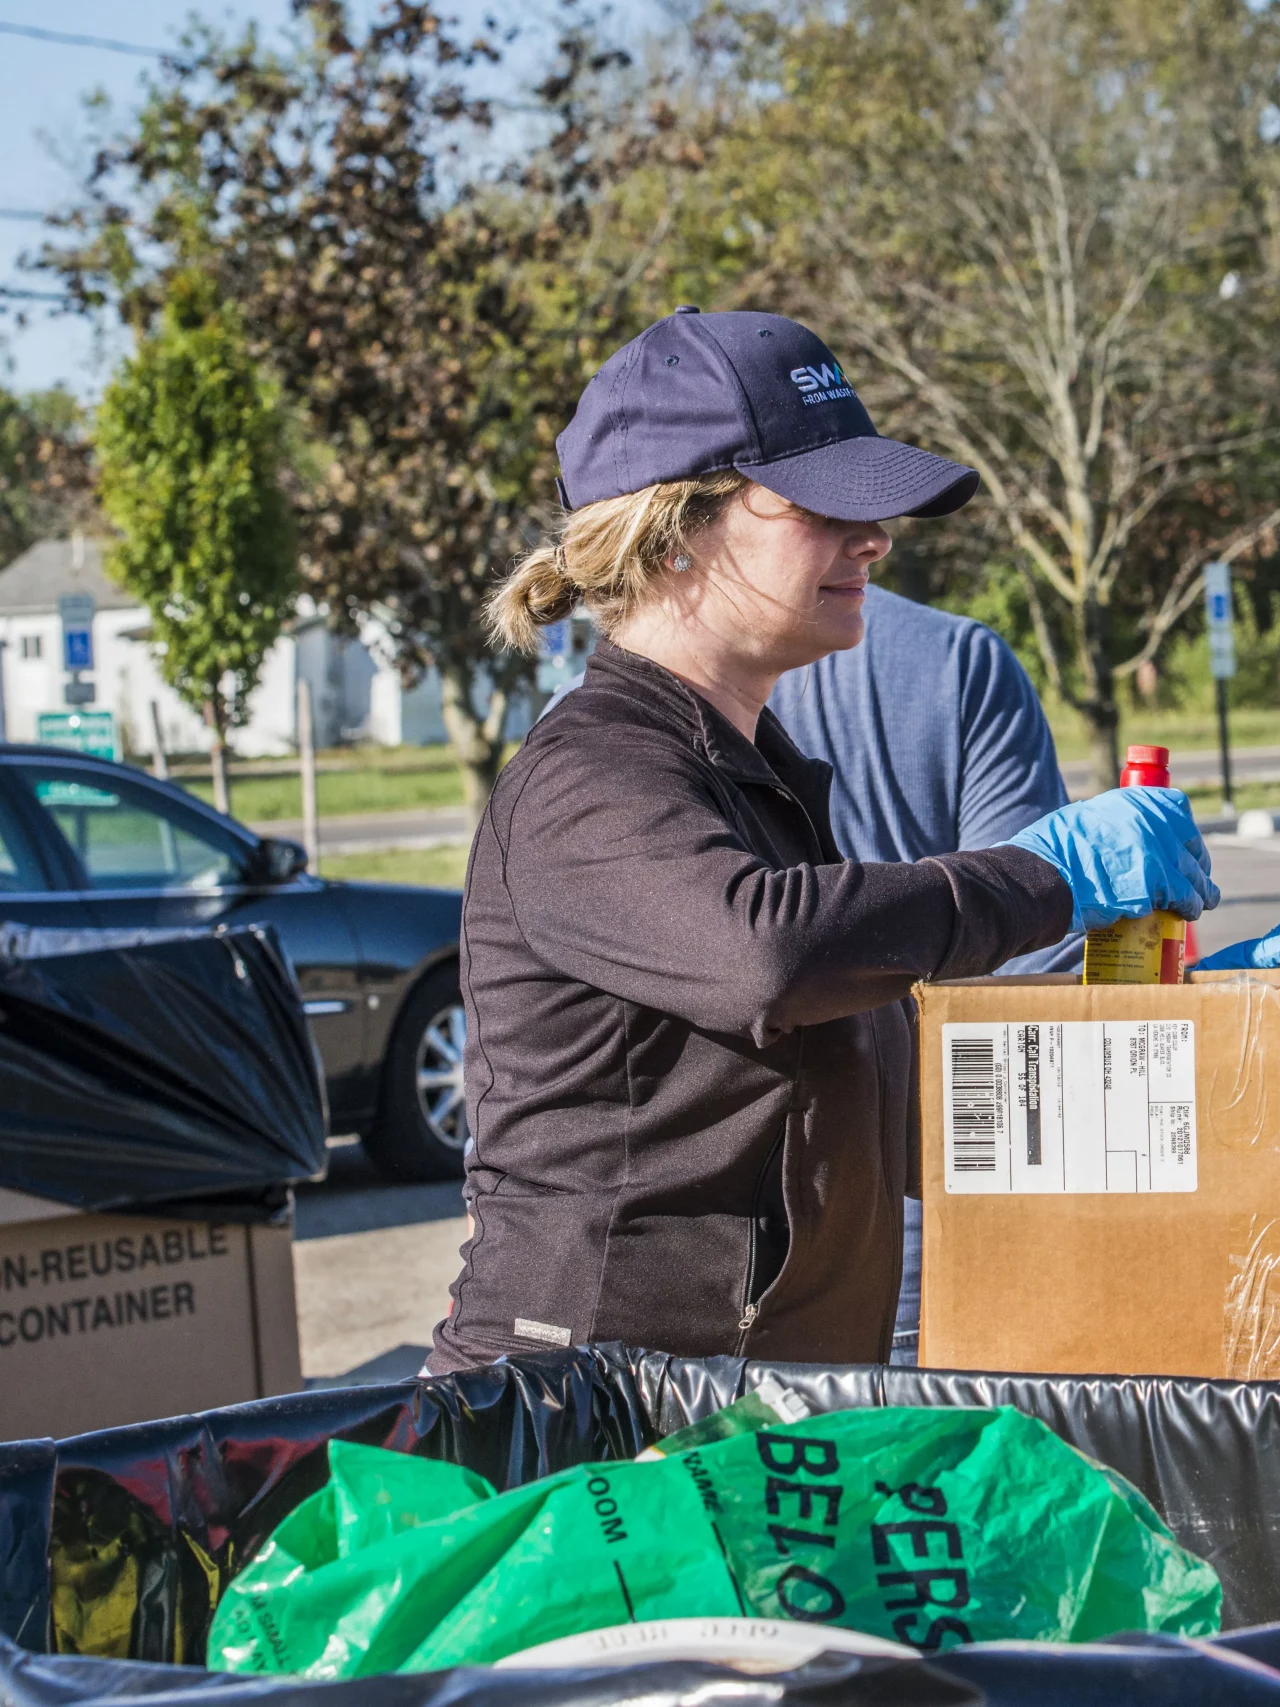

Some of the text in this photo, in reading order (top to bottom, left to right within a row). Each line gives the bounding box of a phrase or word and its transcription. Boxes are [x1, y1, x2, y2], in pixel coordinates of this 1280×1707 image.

[1103, 1037, 1111, 1066] COLUMBUS
[0, 1224, 228, 1291] N-REUSABLE
[0, 1281, 196, 1347] CONTAINER
[587, 1476, 628, 1544] OOM
[757, 1432, 845, 1624] BELO
[870, 1480, 974, 1650] PERS
